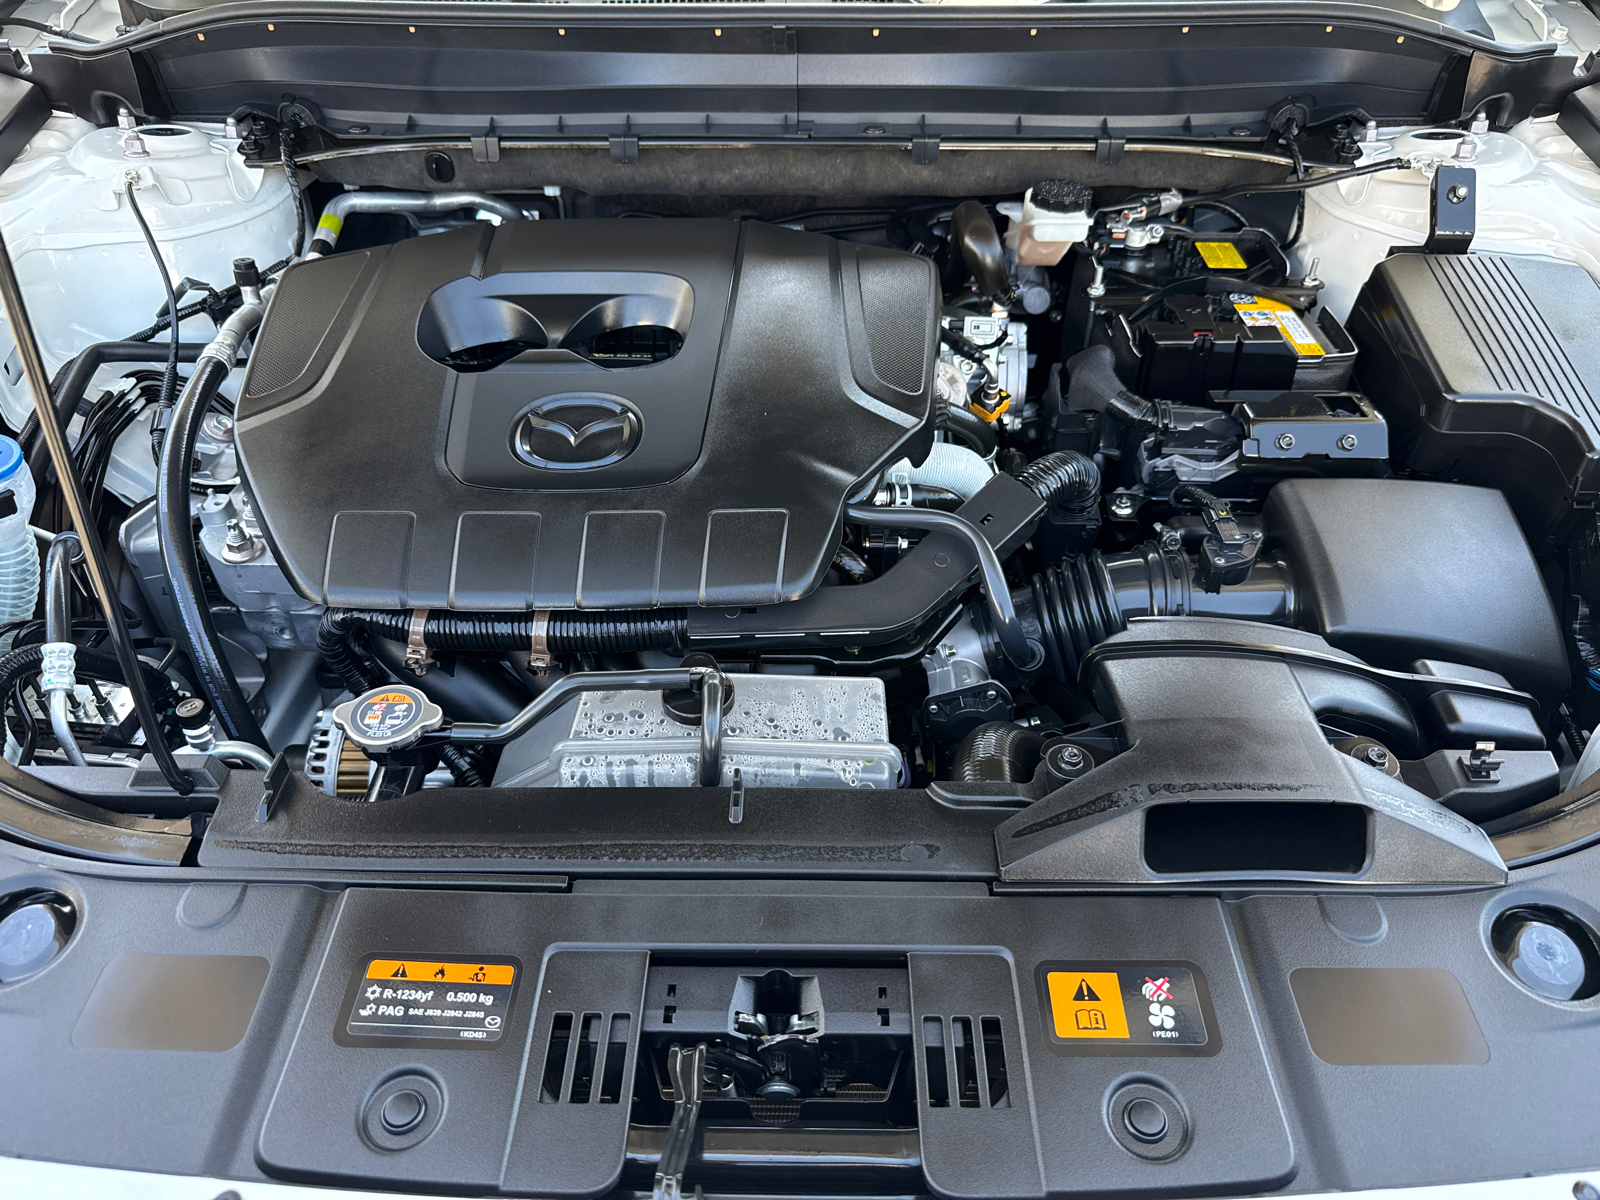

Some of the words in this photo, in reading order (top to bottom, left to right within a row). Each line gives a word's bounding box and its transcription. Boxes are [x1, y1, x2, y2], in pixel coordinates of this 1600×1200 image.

[383, 988, 434, 1001] R-1234yf
[446, 991, 477, 1003] 0.500
[478, 992, 494, 1006] kg
[377, 1005, 405, 1016] PAG
[424, 1009, 441, 1017] J639
[442, 1009, 463, 1018] J2842
[1152, 1030, 1179, 1038] (PE01)
